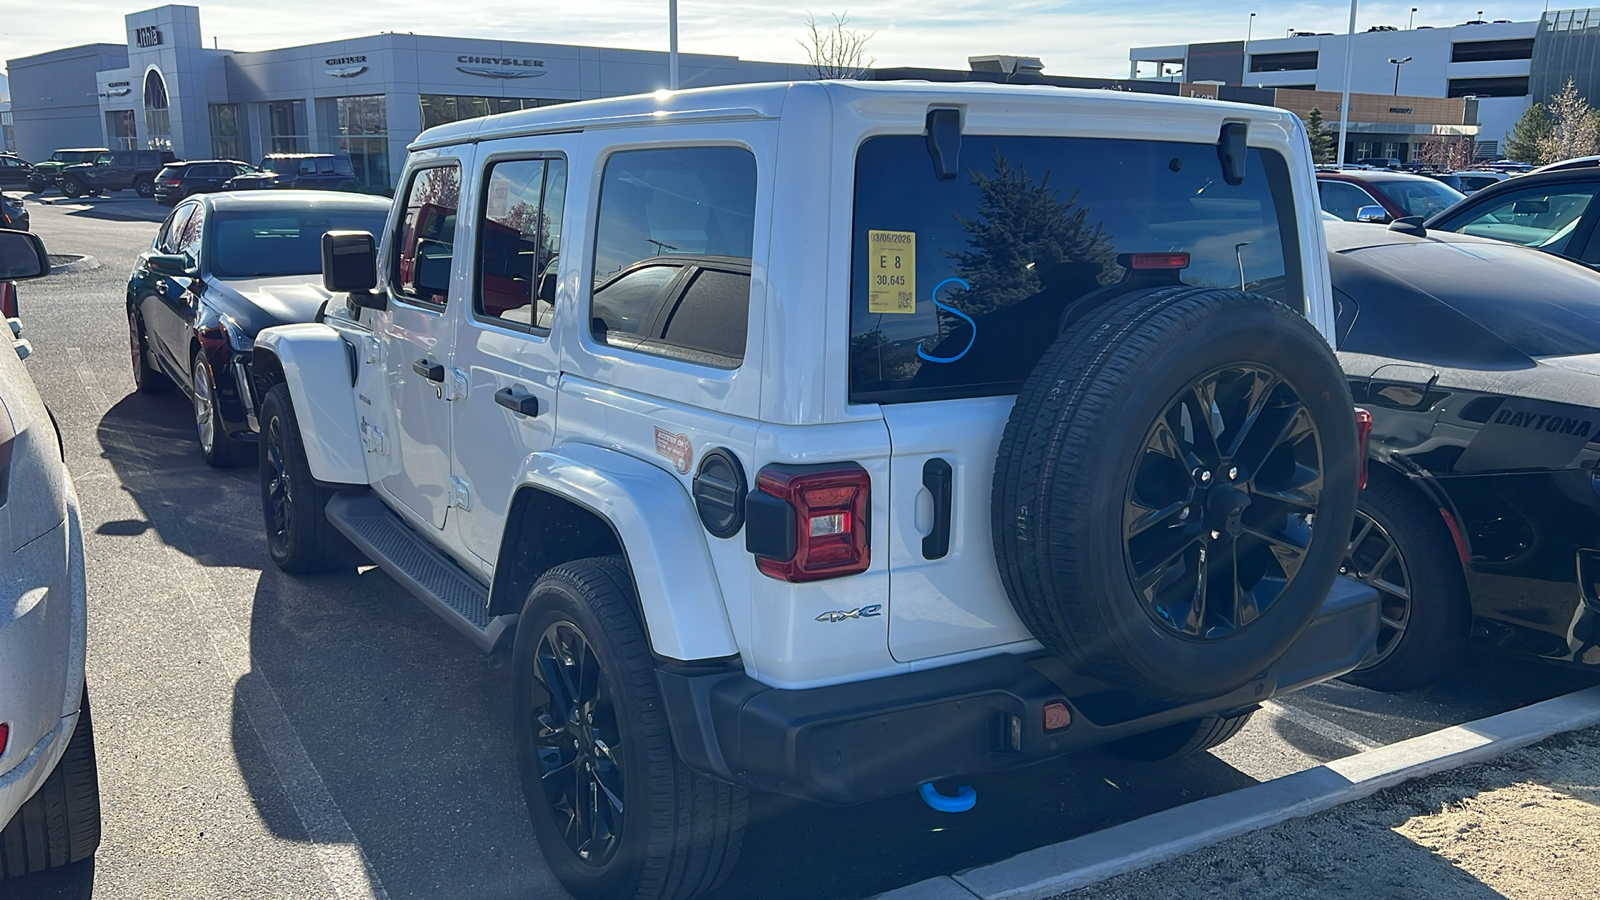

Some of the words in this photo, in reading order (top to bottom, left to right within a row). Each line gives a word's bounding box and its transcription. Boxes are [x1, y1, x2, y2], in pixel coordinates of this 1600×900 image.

[325, 54, 368, 66] CHRYSLER
[457, 55, 545, 67] CHRYSLER
[871, 233, 912, 244] 03/06/2026
[880, 255, 887, 268] E
[894, 255, 901, 269] 8
[876, 274, 905, 286] 30,645
[917, 277, 977, 364] S
[1494, 408, 1592, 438] DAYTONA
